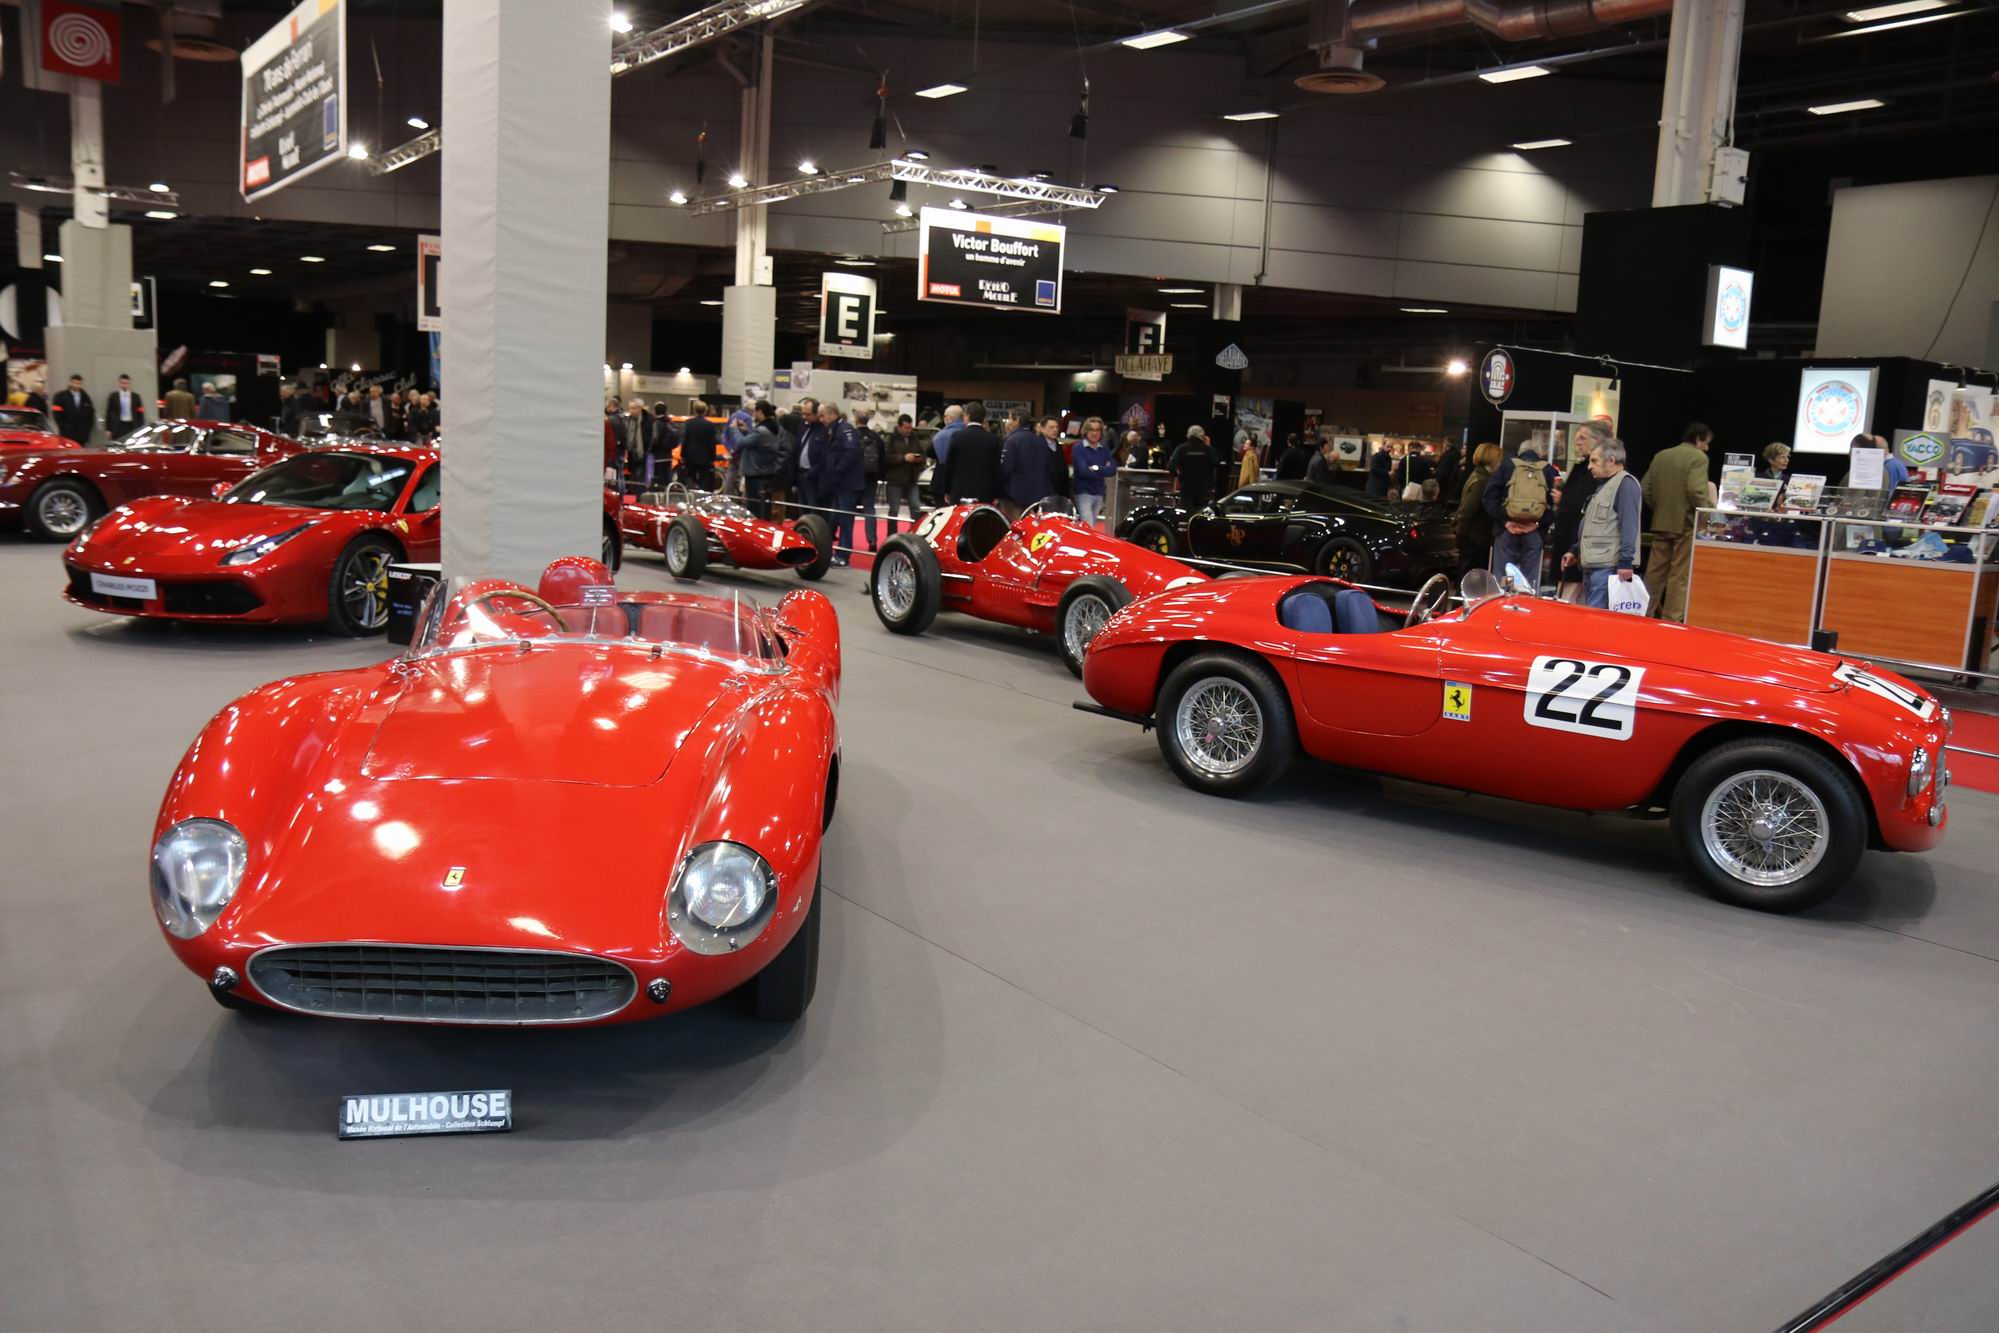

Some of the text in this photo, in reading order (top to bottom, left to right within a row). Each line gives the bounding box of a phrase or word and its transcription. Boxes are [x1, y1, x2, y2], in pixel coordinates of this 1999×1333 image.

[952, 233, 1039, 258] Victor Bouffort
[975, 253, 999, 264] homme
[1000, 256, 1026, 267] d'avenir
[930, 284, 960, 295] MOTUL
[838, 296, 860, 338] E
[1117, 356, 1170, 373] DELAHAYE
[1905, 443, 1939, 454] YACCO
[1534, 658, 1631, 730] 22
[346, 1093, 506, 1124] MULHOUSE
[446, 1120, 476, 1128] Collection
[476, 1119, 506, 1128] Schlumpf
